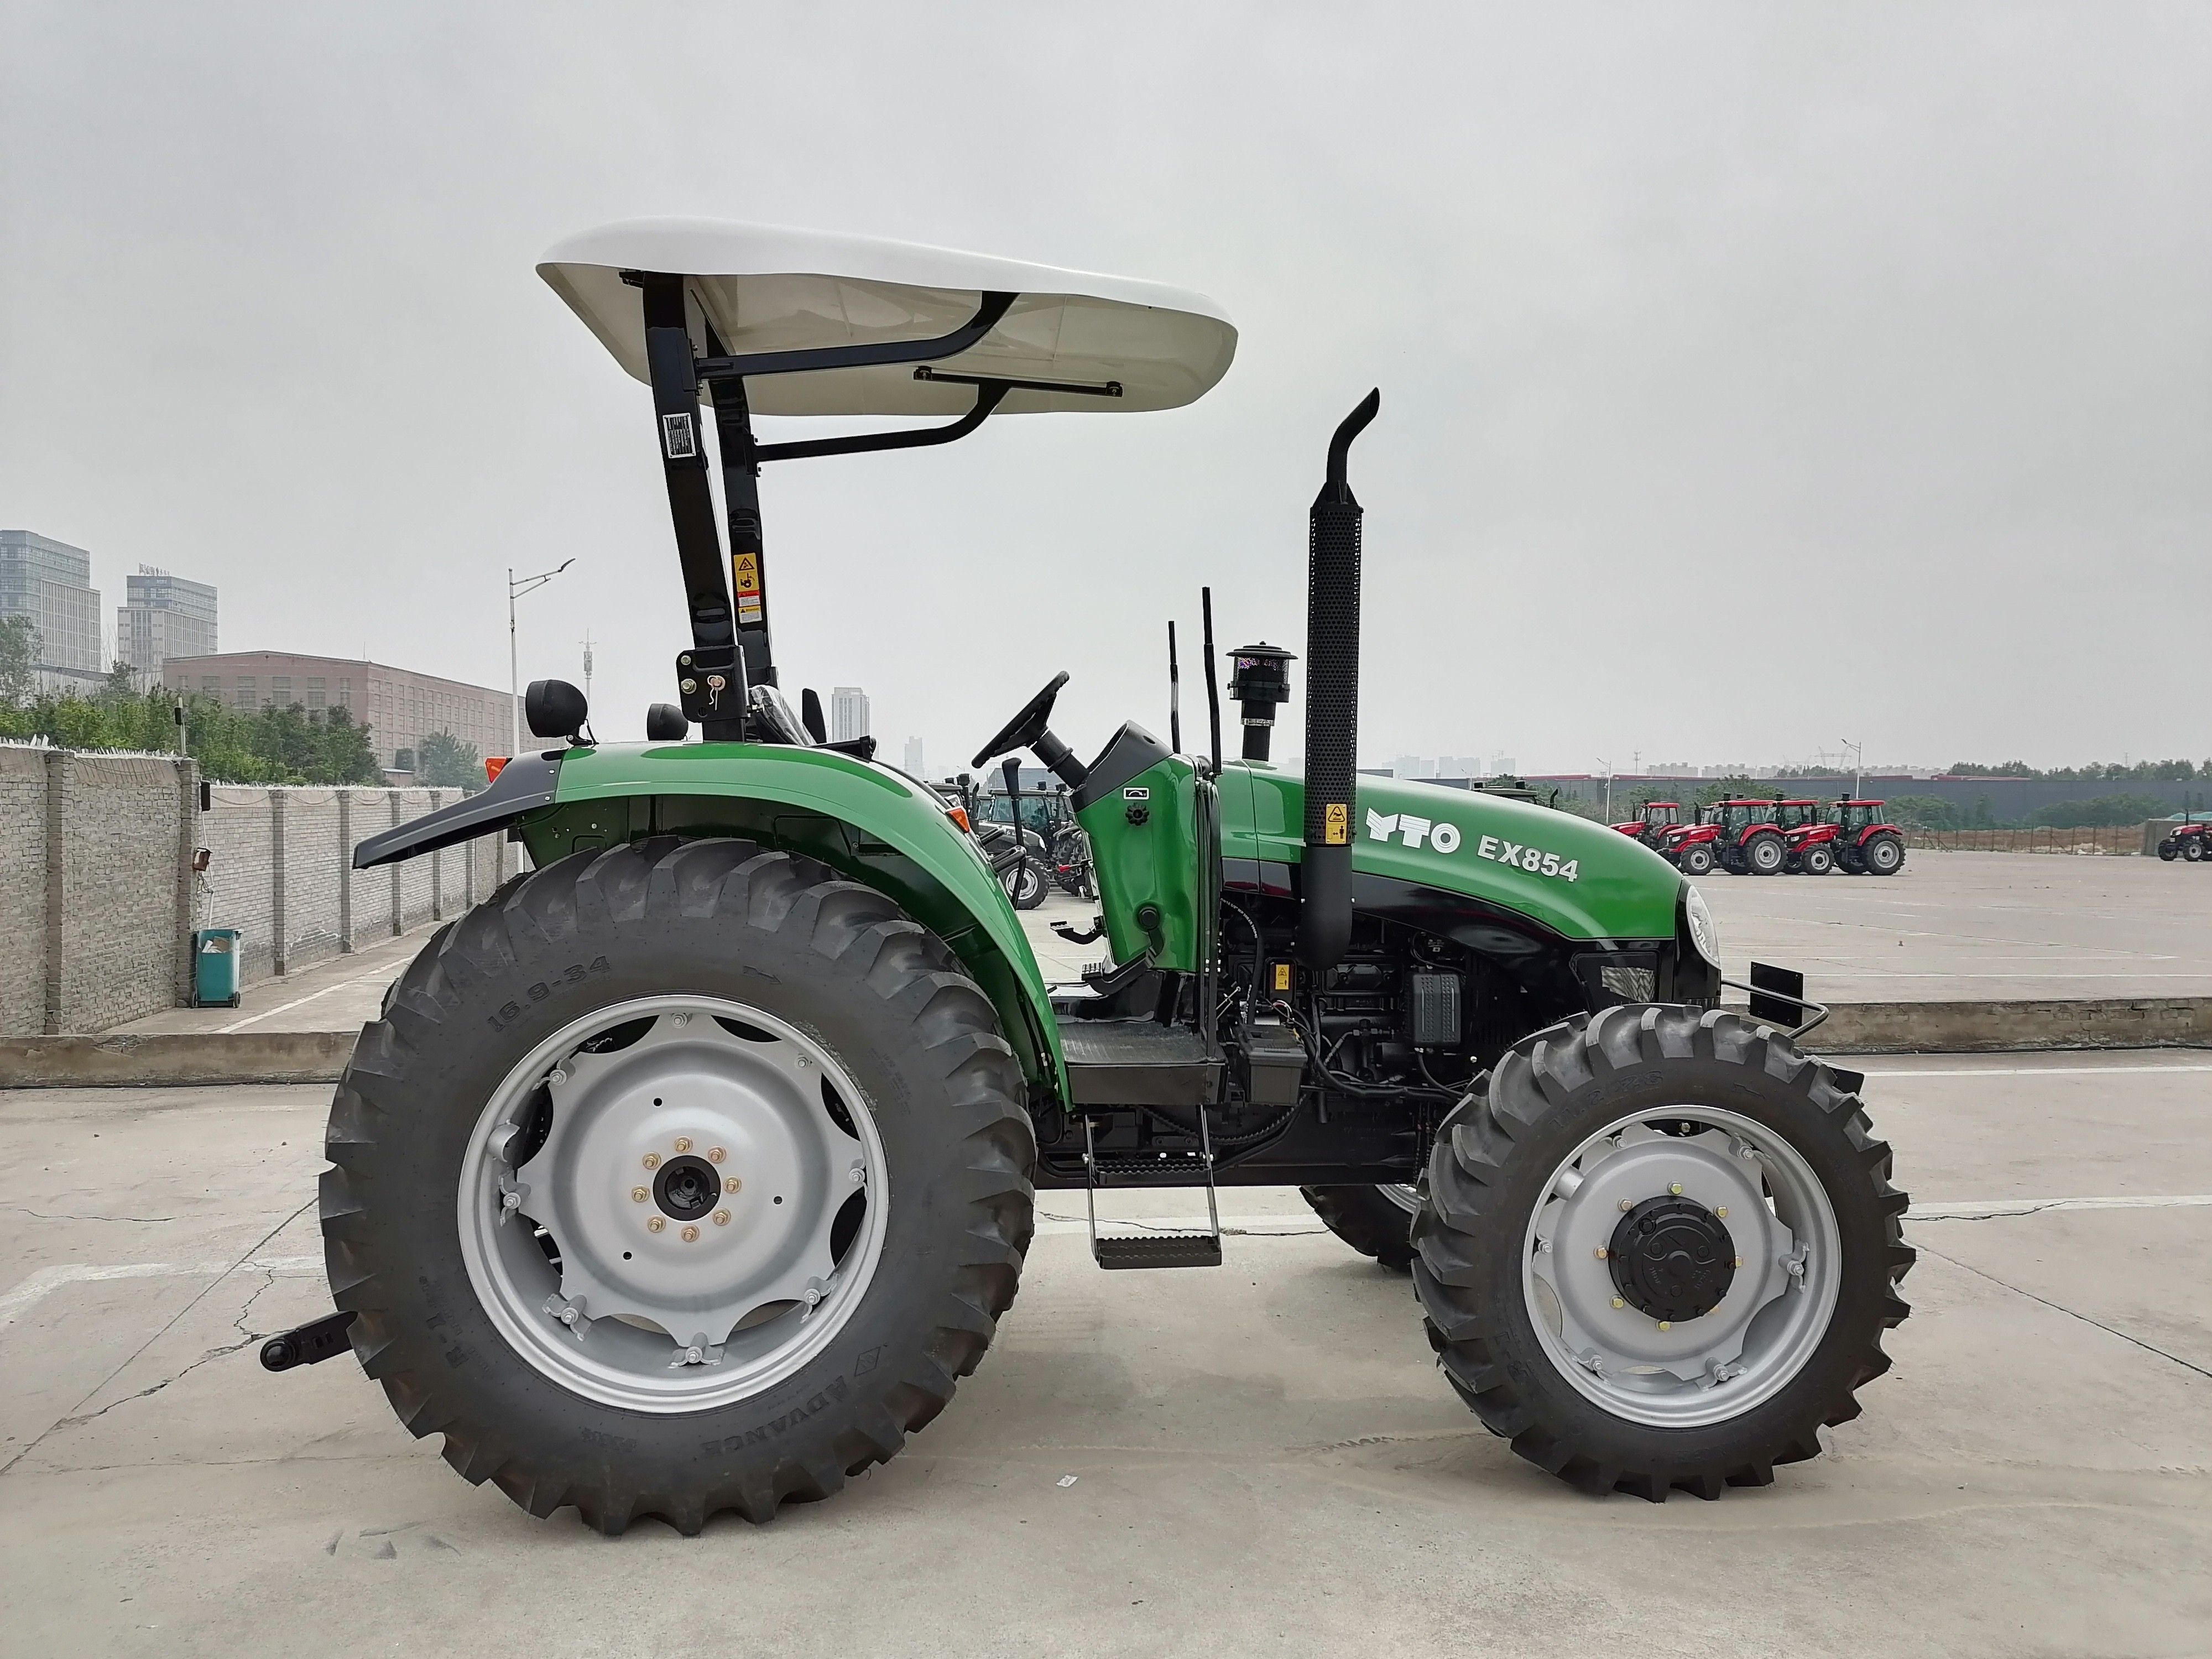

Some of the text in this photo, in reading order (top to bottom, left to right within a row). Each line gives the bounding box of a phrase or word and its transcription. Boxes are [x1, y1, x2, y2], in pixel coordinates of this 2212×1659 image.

[1365, 806, 1579, 883] YTO EX854
[487, 955, 612, 1032] 16.9-34
[700, 1375, 851, 1454] ADVANCE
